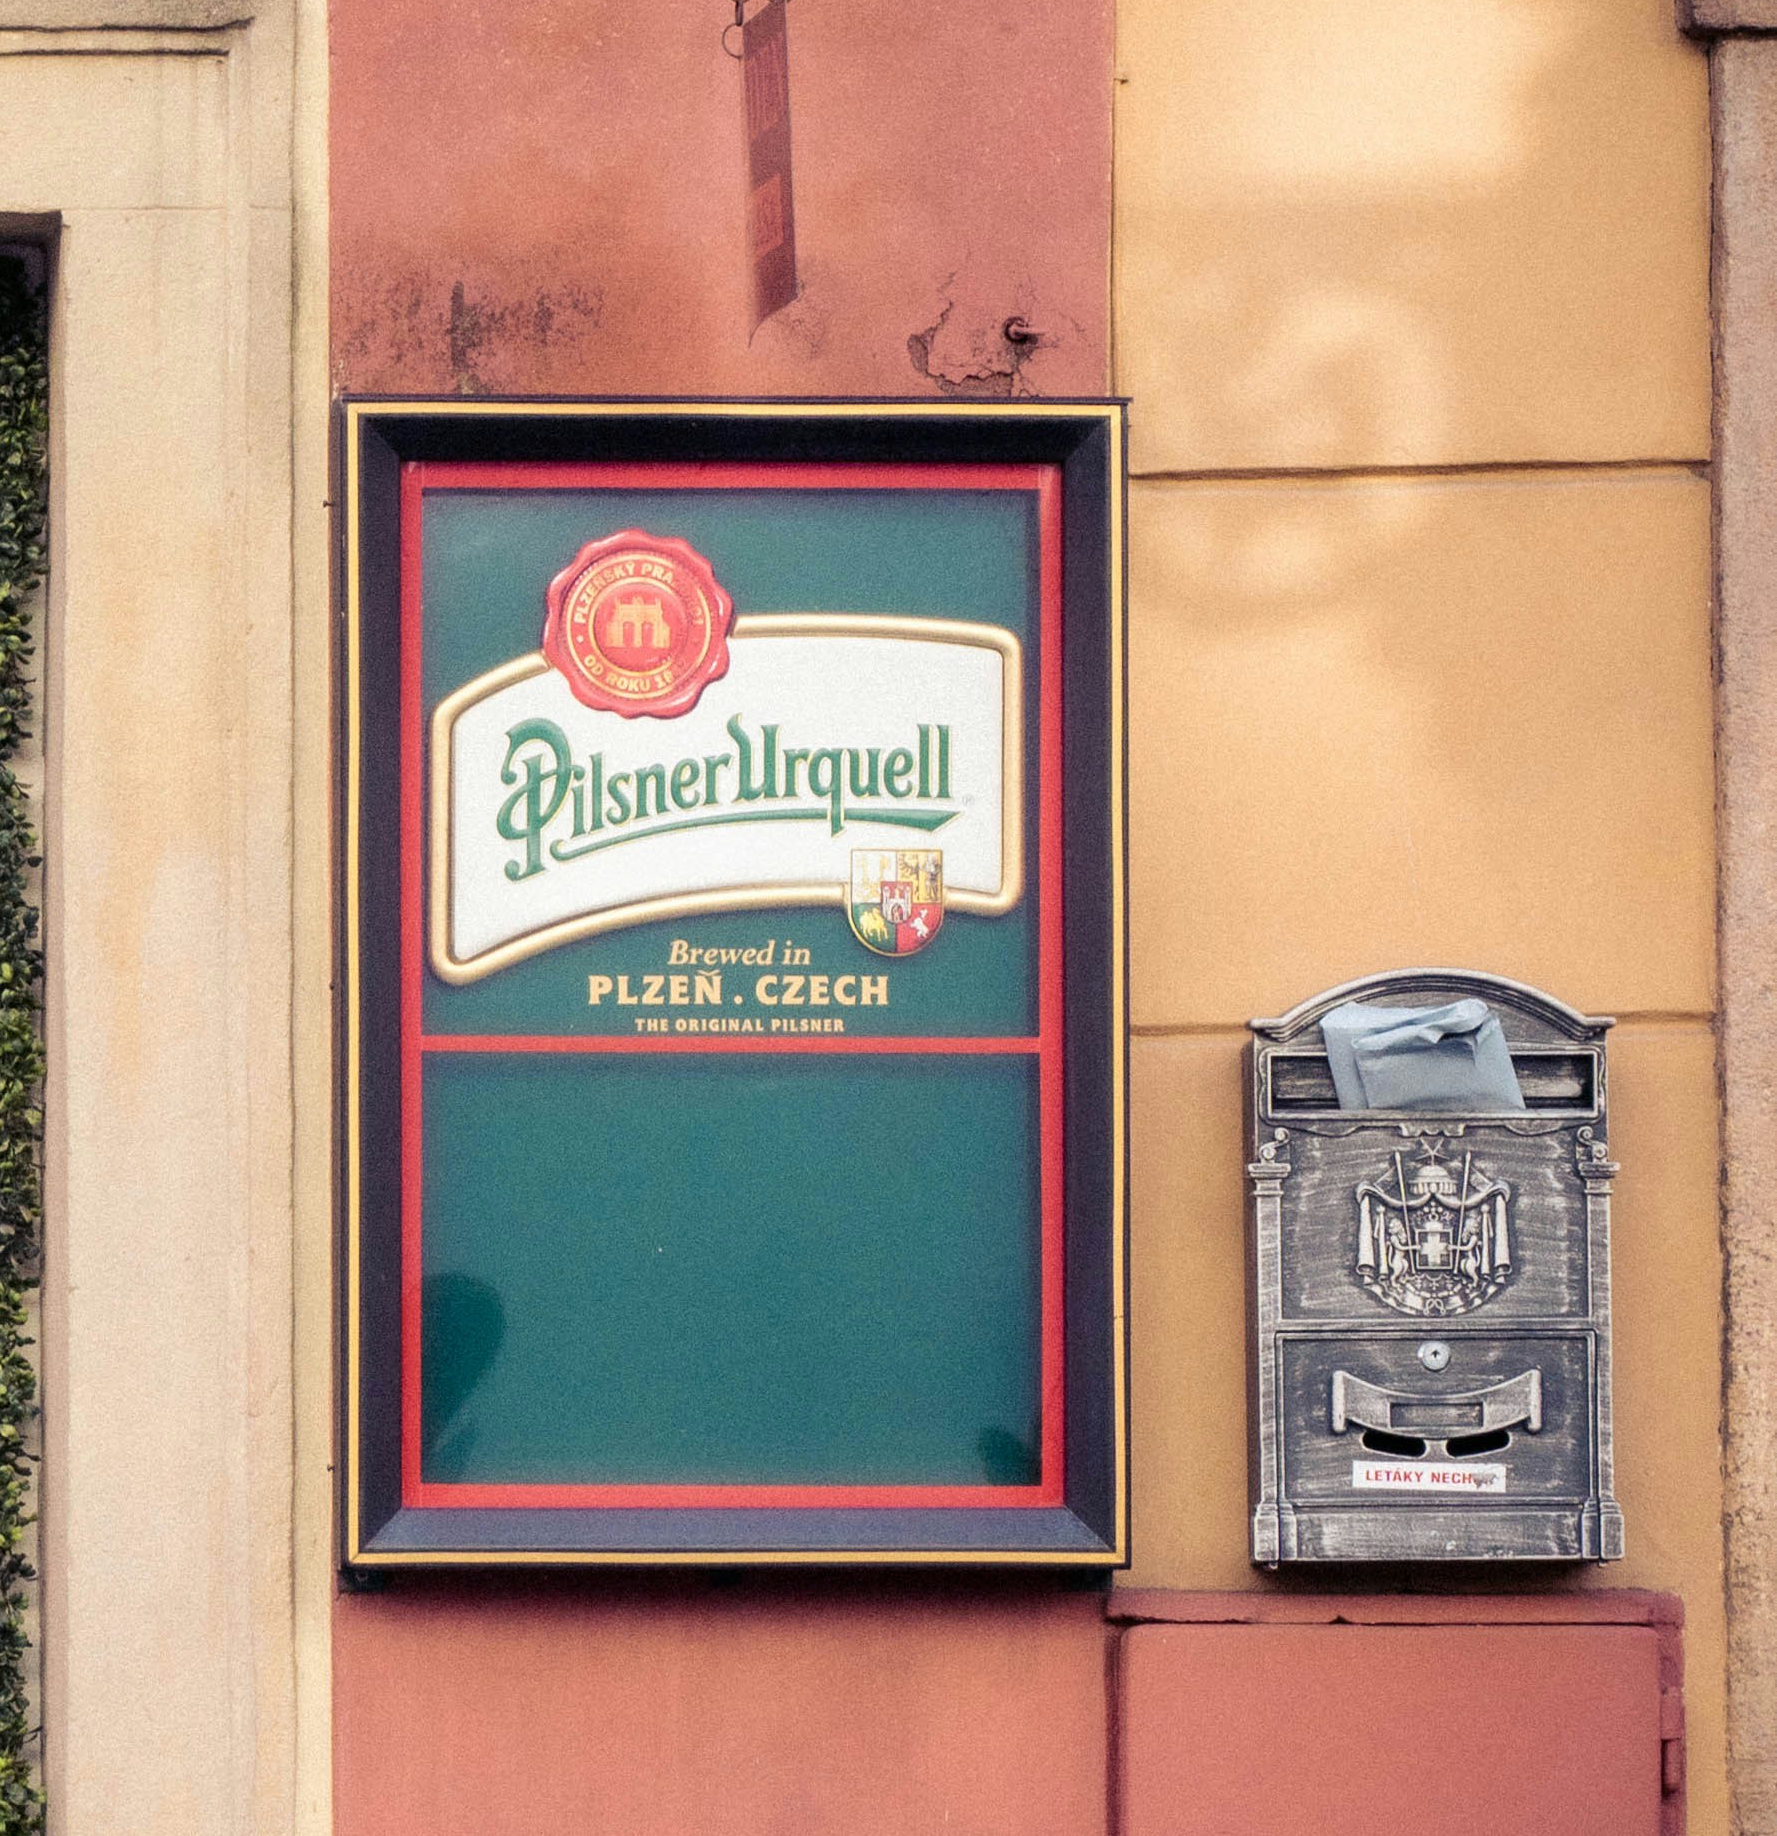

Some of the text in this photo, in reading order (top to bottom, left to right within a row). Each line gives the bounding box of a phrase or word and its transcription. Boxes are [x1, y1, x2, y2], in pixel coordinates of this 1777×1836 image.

[584, 654, 604, 676] OD
[605, 670, 653, 693] ROKU
[496, 712, 953, 882] Pilsner Urquell
[667, 938, 811, 966] Brewed in
[588, 968, 722, 1006] PLZEŇ
[755, 974, 890, 1006] CZECH
[634, 1017, 845, 1033] THE ORIGINAL PILSNER
[1365, 1467, 1424, 1484] LETÁKY
